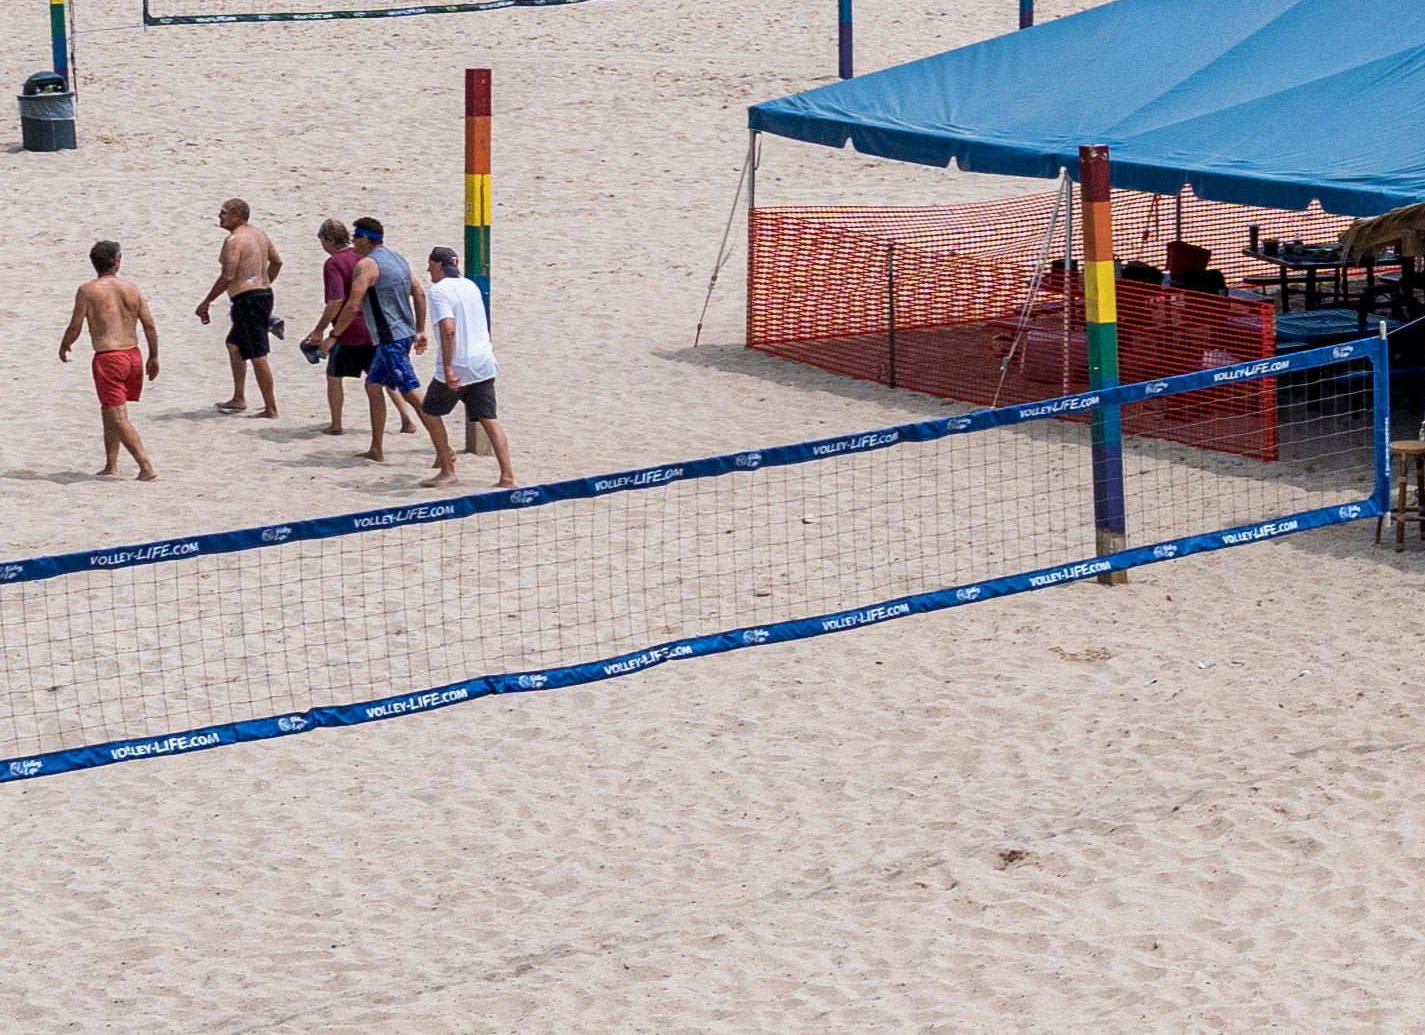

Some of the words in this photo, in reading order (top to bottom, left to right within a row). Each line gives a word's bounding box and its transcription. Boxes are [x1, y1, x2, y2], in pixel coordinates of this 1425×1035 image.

[1213, 359, 1290, 382] VOLLEY-LIFE.COM
[1019, 396, 1100, 419] VOLLEY-LIFE.COM
[812, 432, 899, 456] VOLLEY-LIFE.COM
[353, 504, 455, 529] VOLLEY-LIFE.COM
[1222, 519, 1298, 545] VOLLEY-LIFE.COM
[90, 542, 199, 566] VOLLEY-LIFE.COM
[1029, 560, 1112, 587] VOLLEY-LIFE.COM
[822, 603, 910, 631] VOLLEY-LIFE.COM
[366, 687, 468, 719] VOLLEY-LIFE.COM
[111, 732, 220, 760] VOLLEY-LIFE.COM
